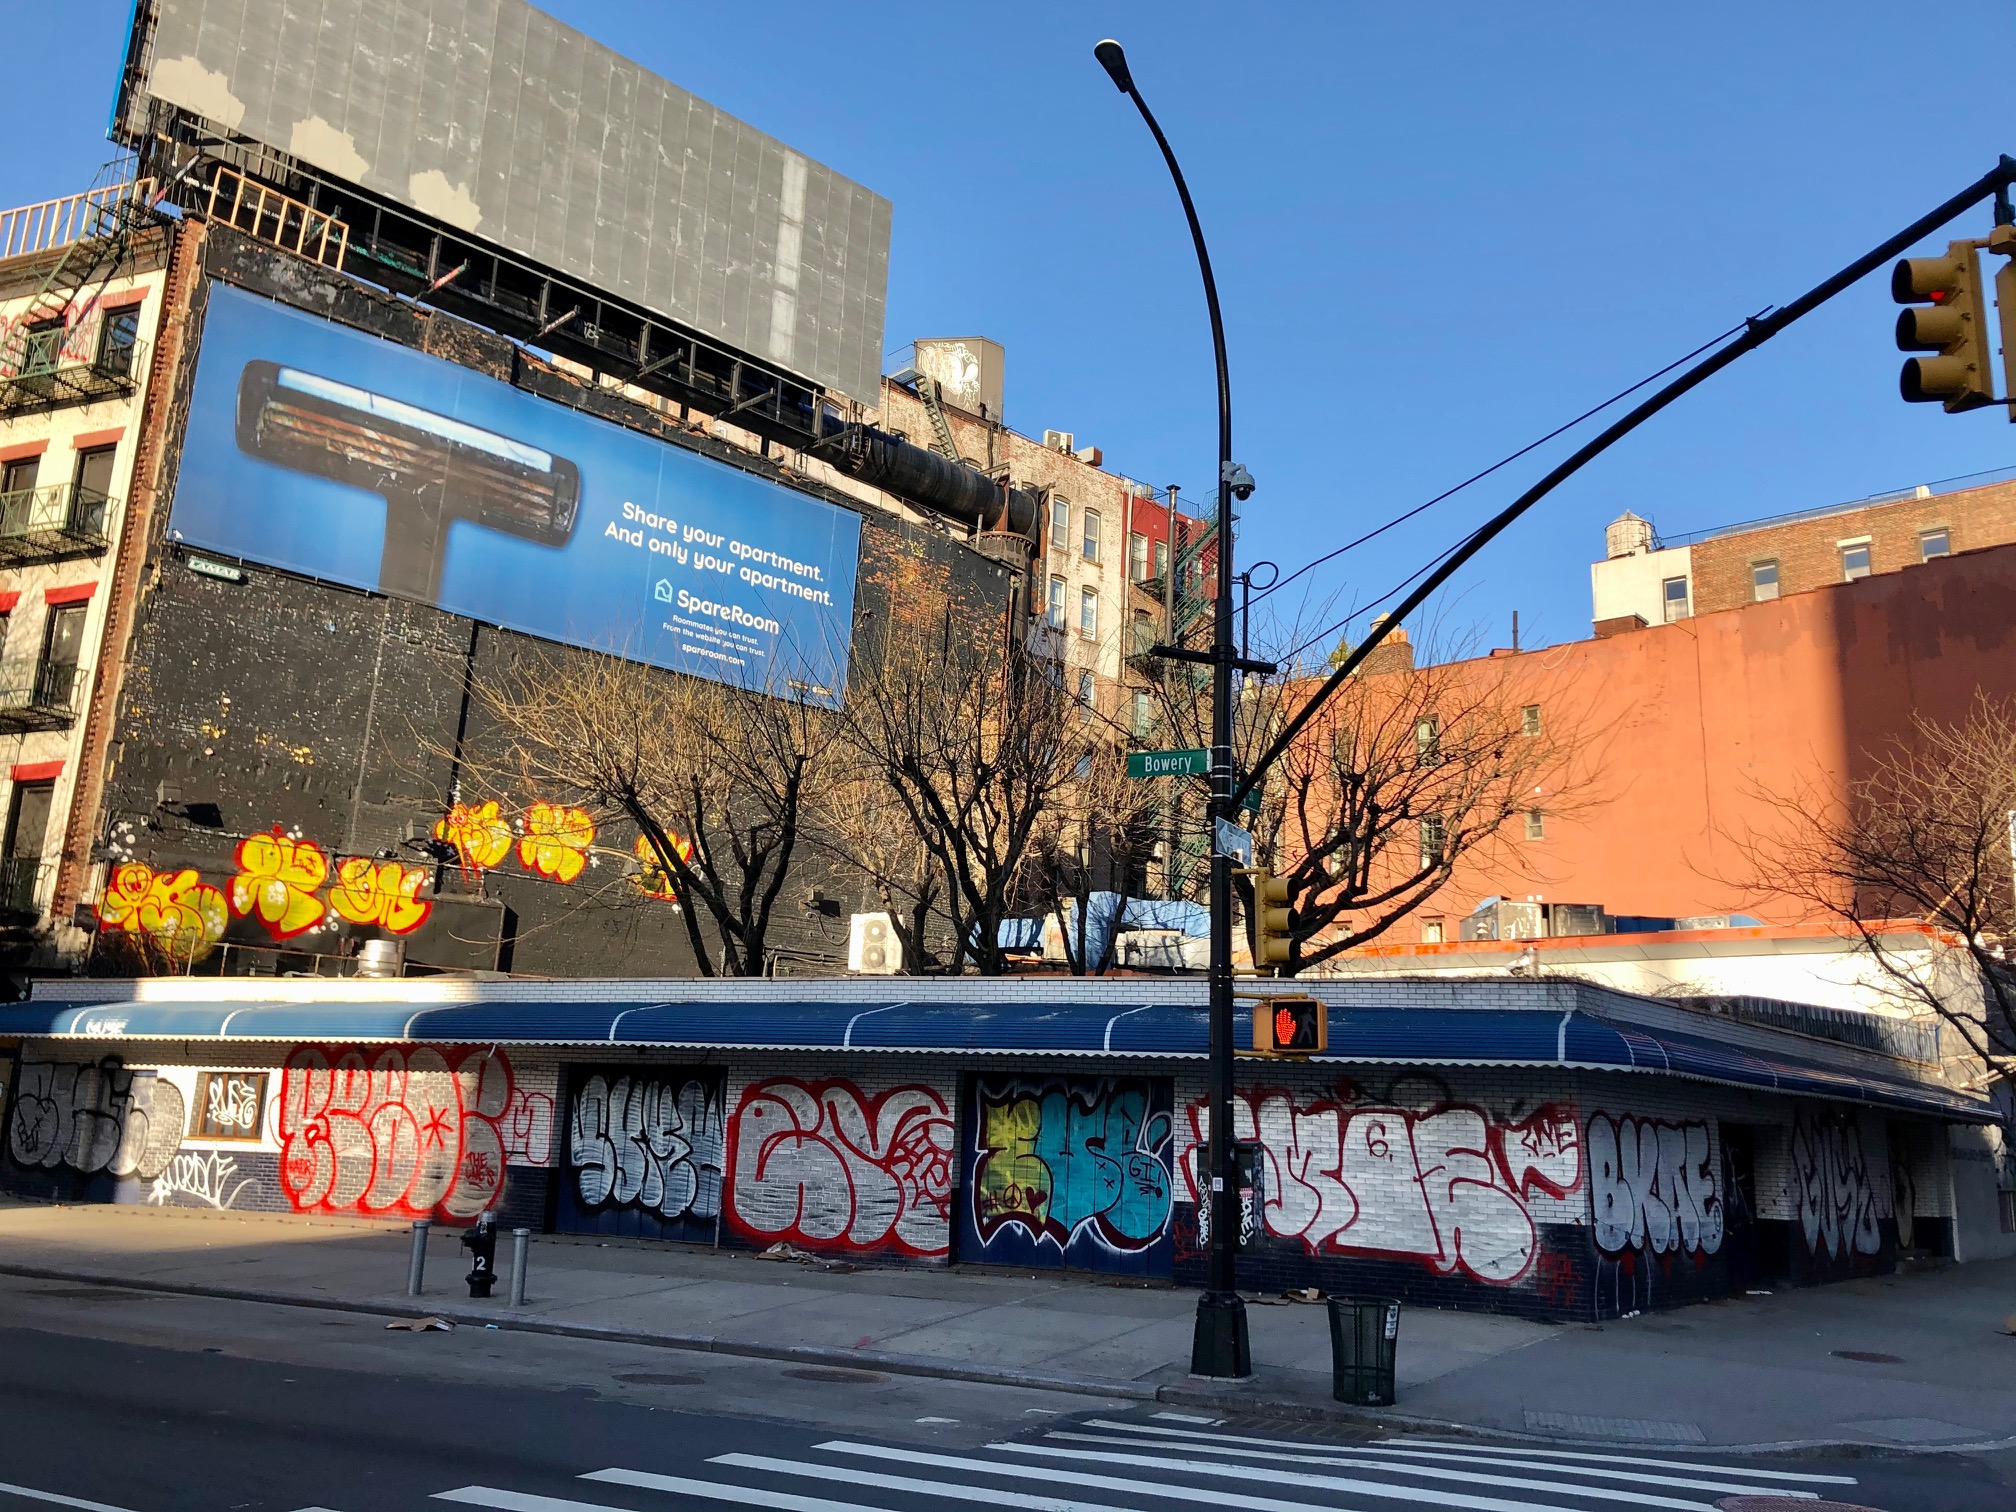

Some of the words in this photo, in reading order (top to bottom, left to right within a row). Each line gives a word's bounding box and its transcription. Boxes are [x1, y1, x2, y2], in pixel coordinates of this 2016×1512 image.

[622, 501, 678, 534] Share
[683, 525, 725, 548] your
[729, 540, 824, 582] apartment.
[604, 521, 644, 547] And
[648, 538, 688, 564] only
[693, 551, 736, 575] your
[740, 566, 834, 607] apartment.
[677, 589, 780, 635] SpareRoom
[662, 622, 681, 634] From
[682, 627, 694, 637] the
[695, 631, 721, 645] website
[735, 643, 748, 653] can
[749, 645, 766, 658] trust.
[672, 614, 714, 633] Roommates
[714, 627, 727, 636] you
[742, 634, 759, 646] trust.
[682, 643, 746, 667] spareroom.com
[1145, 755, 1192, 773] Bowery
[476, 1256, 486, 1270] 2
